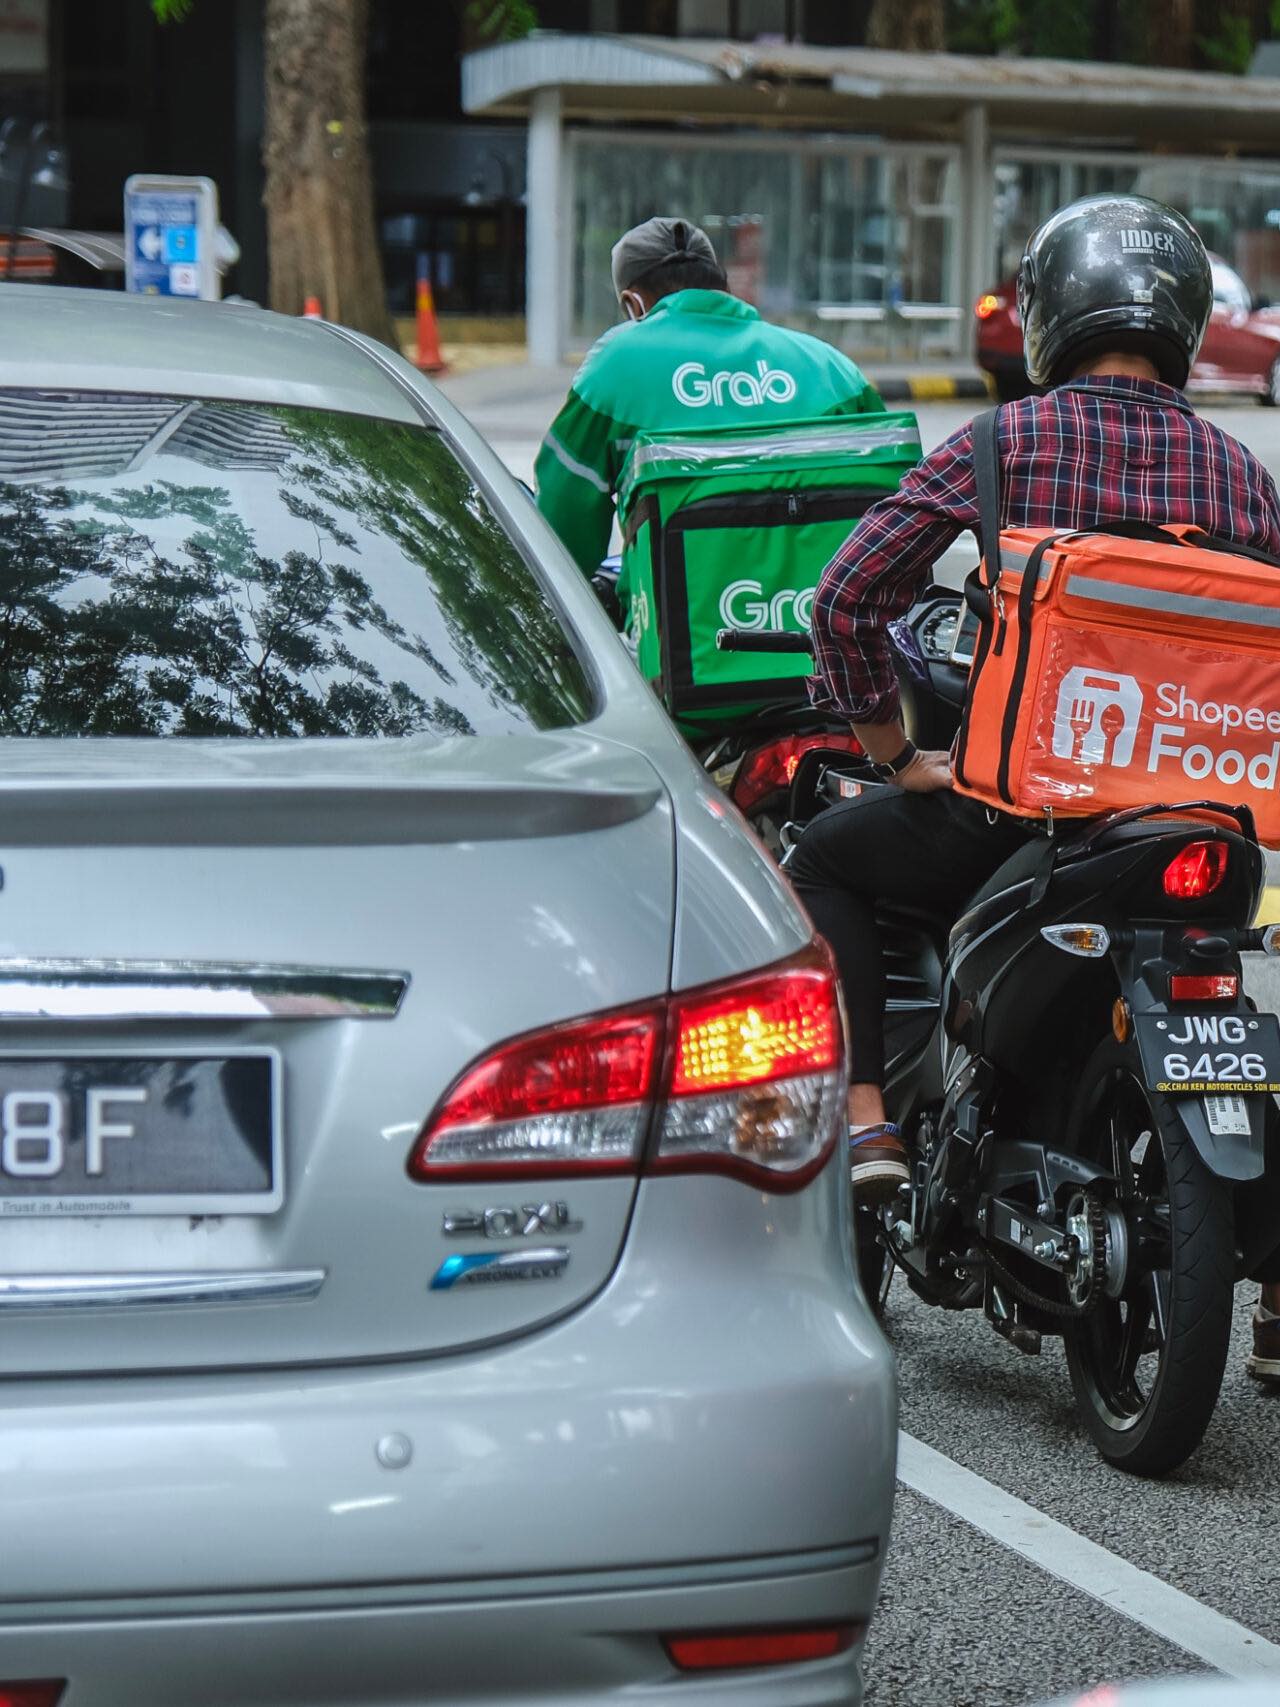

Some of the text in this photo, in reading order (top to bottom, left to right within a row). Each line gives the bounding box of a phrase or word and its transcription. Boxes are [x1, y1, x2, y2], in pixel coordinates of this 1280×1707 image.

[1120, 229, 1175, 253] INDEX
[671, 359, 797, 407] Grab
[1146, 722, 1280, 790] Food
[1167, 1016, 1246, 1045] JWG
[1163, 1053, 1267, 1081] 6426
[1206, 1083, 1253, 1091] MOTORCYCLES
[56, 1200, 131, 1212] Automobile
